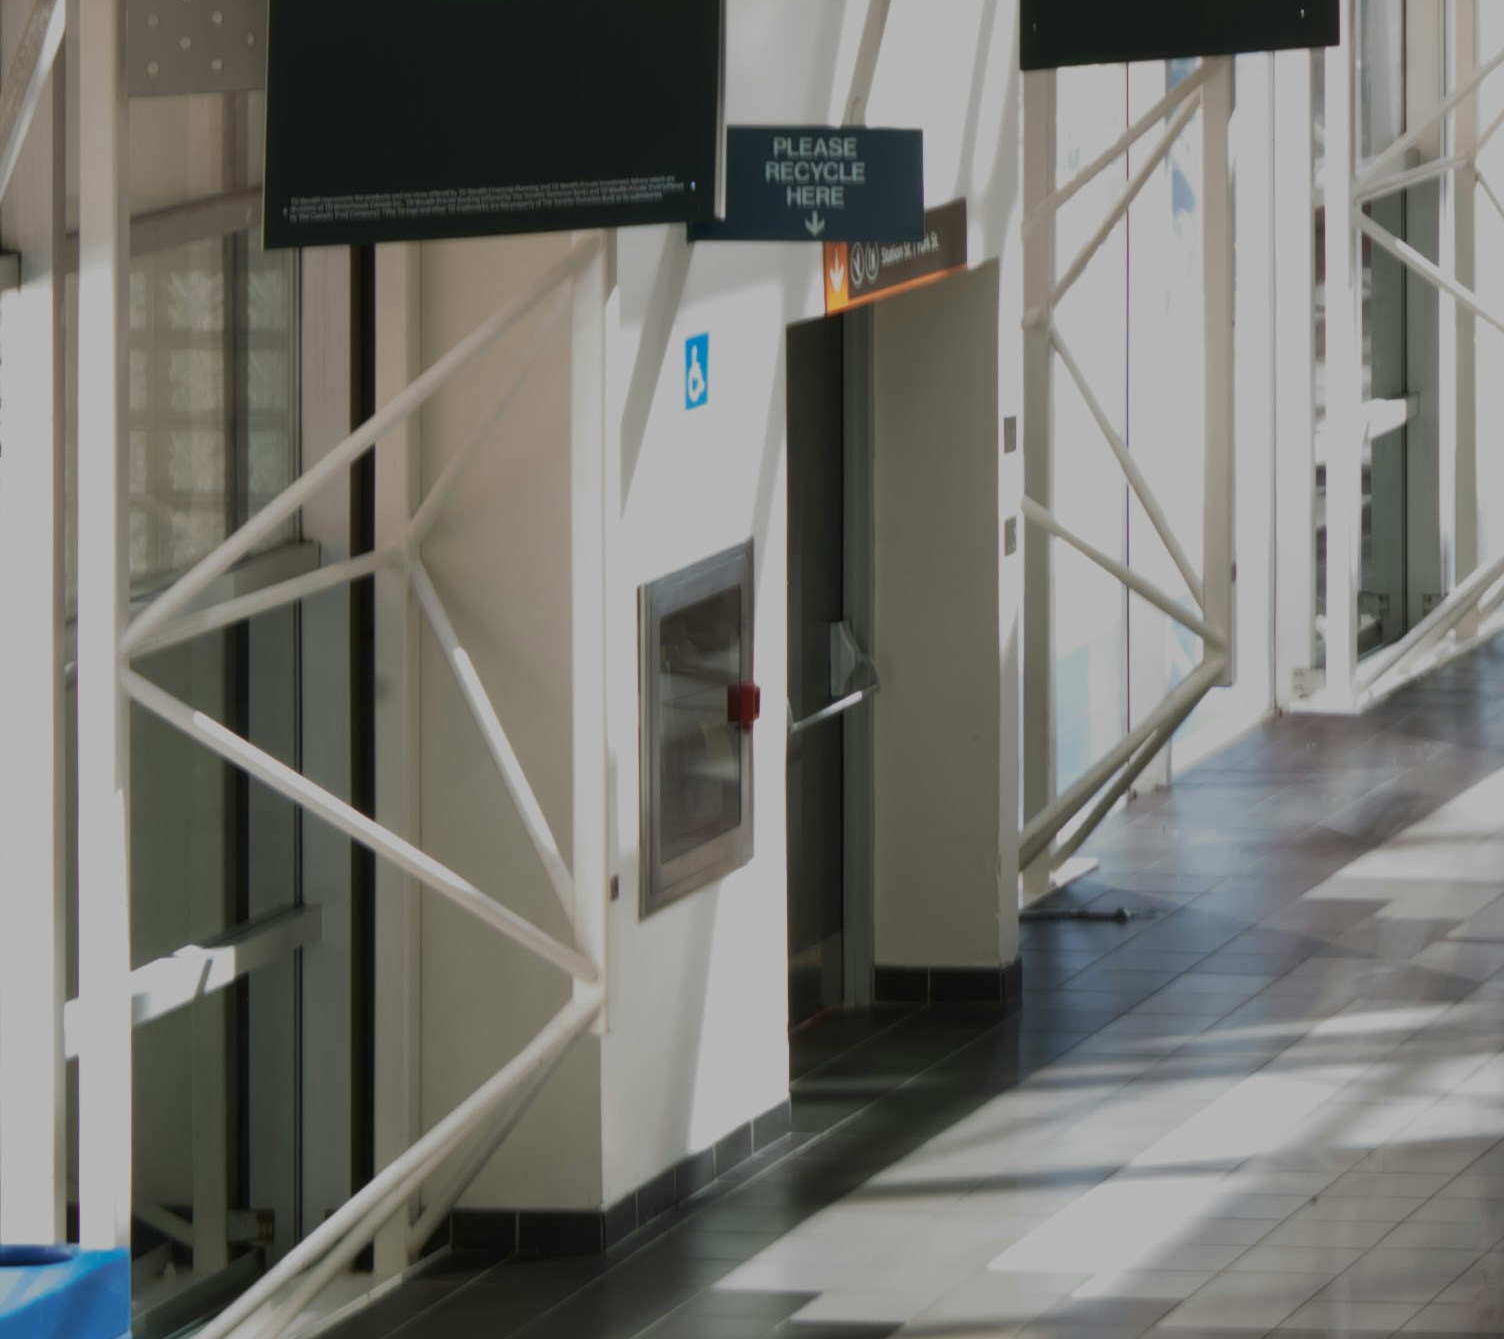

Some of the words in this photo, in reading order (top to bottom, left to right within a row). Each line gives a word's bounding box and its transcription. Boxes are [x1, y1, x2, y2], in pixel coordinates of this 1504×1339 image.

[773, 137, 857, 158] PLEASE
[765, 161, 865, 183] RECYCLE
[786, 186, 844, 207] HERE
